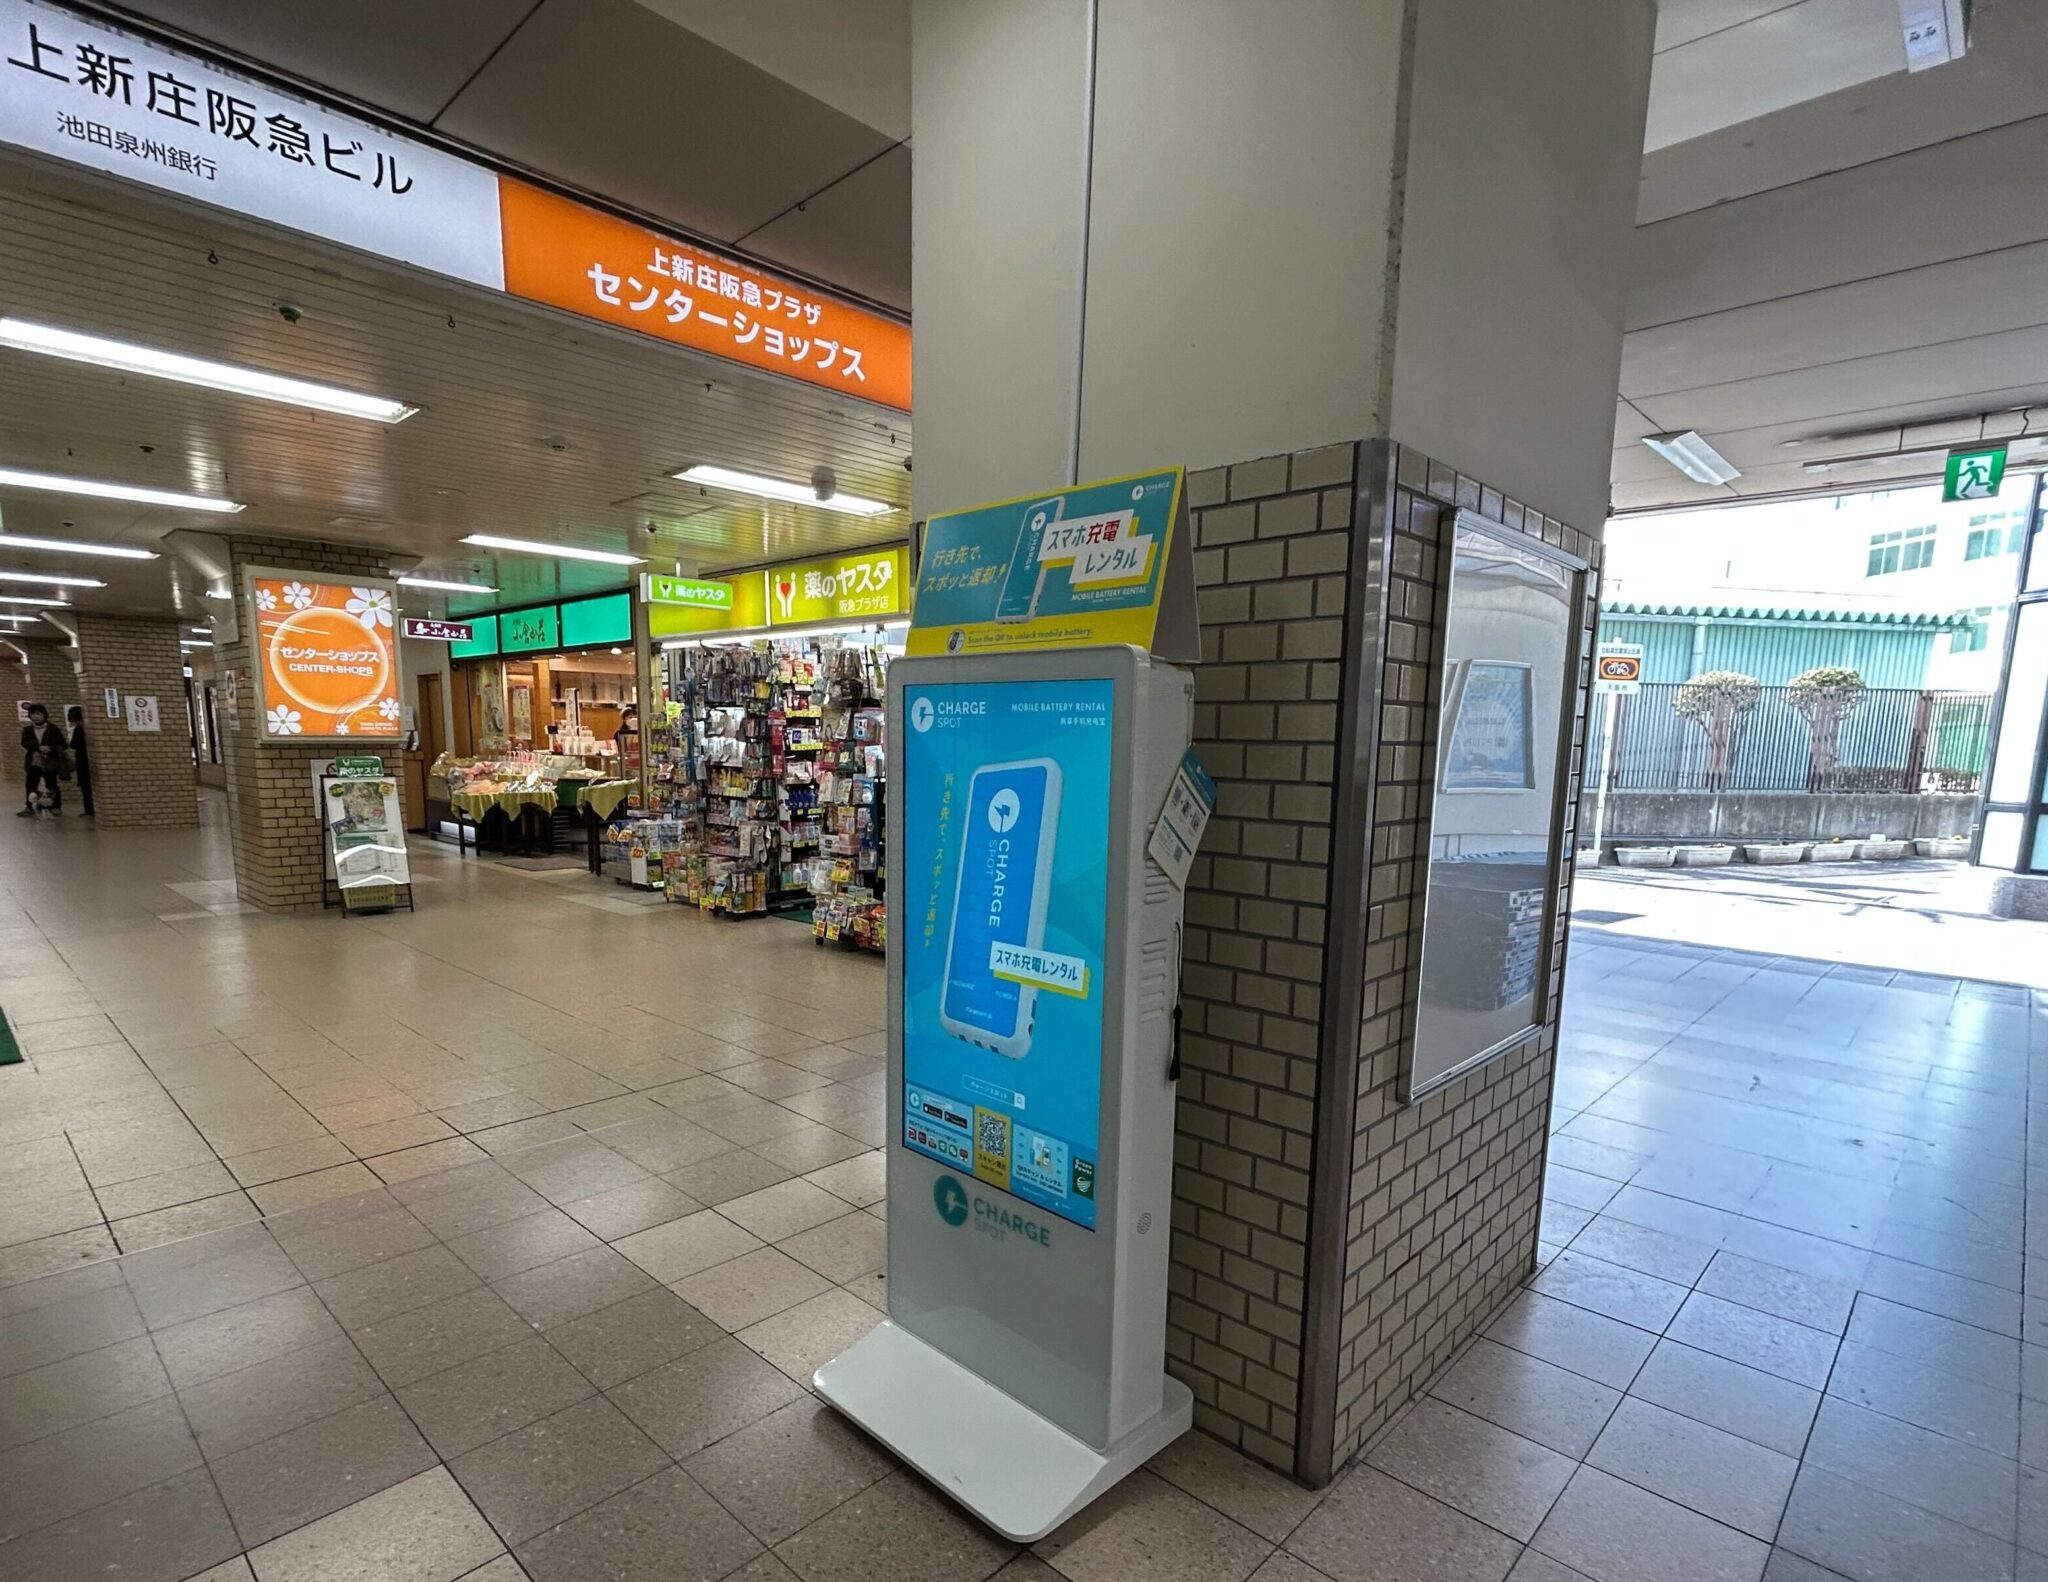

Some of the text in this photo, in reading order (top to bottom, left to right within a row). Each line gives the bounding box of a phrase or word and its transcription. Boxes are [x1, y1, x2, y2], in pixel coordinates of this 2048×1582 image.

[8, 22, 414, 196] 上新庄阪急ビル
[56, 111, 218, 182] 池田泉州銀行
[646, 246, 822, 326] 上新庄阪急プラザ
[586, 262, 866, 382] センターショップス
[1047, 519, 1120, 551] スマホ充電
[1084, 547, 1137, 575] レンタル
[839, 595, 889, 614] 阪急プラザ店
[1072, 591, 1095, 601] MOBILE
[1095, 589, 1121, 599] BATTERY
[1122, 586, 1147, 596] RENTAL
[279, 646, 380, 663] センターショップス
[289, 662, 374, 675] CENTER-SHOPS
[937, 701, 987, 715] CHARGE
[1011, 702, 1106, 712] MOBILE BATTERY RENTAL
[937, 716, 962, 729] SPOT
[985, 839, 998, 878] SPOT
[988, 838, 1010, 928] CHARGE
[996, 949, 1078, 982] スマホ充電レンタル
[973, 1197, 1051, 1248] CHARGE
[974, 1217, 1008, 1244] SPOT
